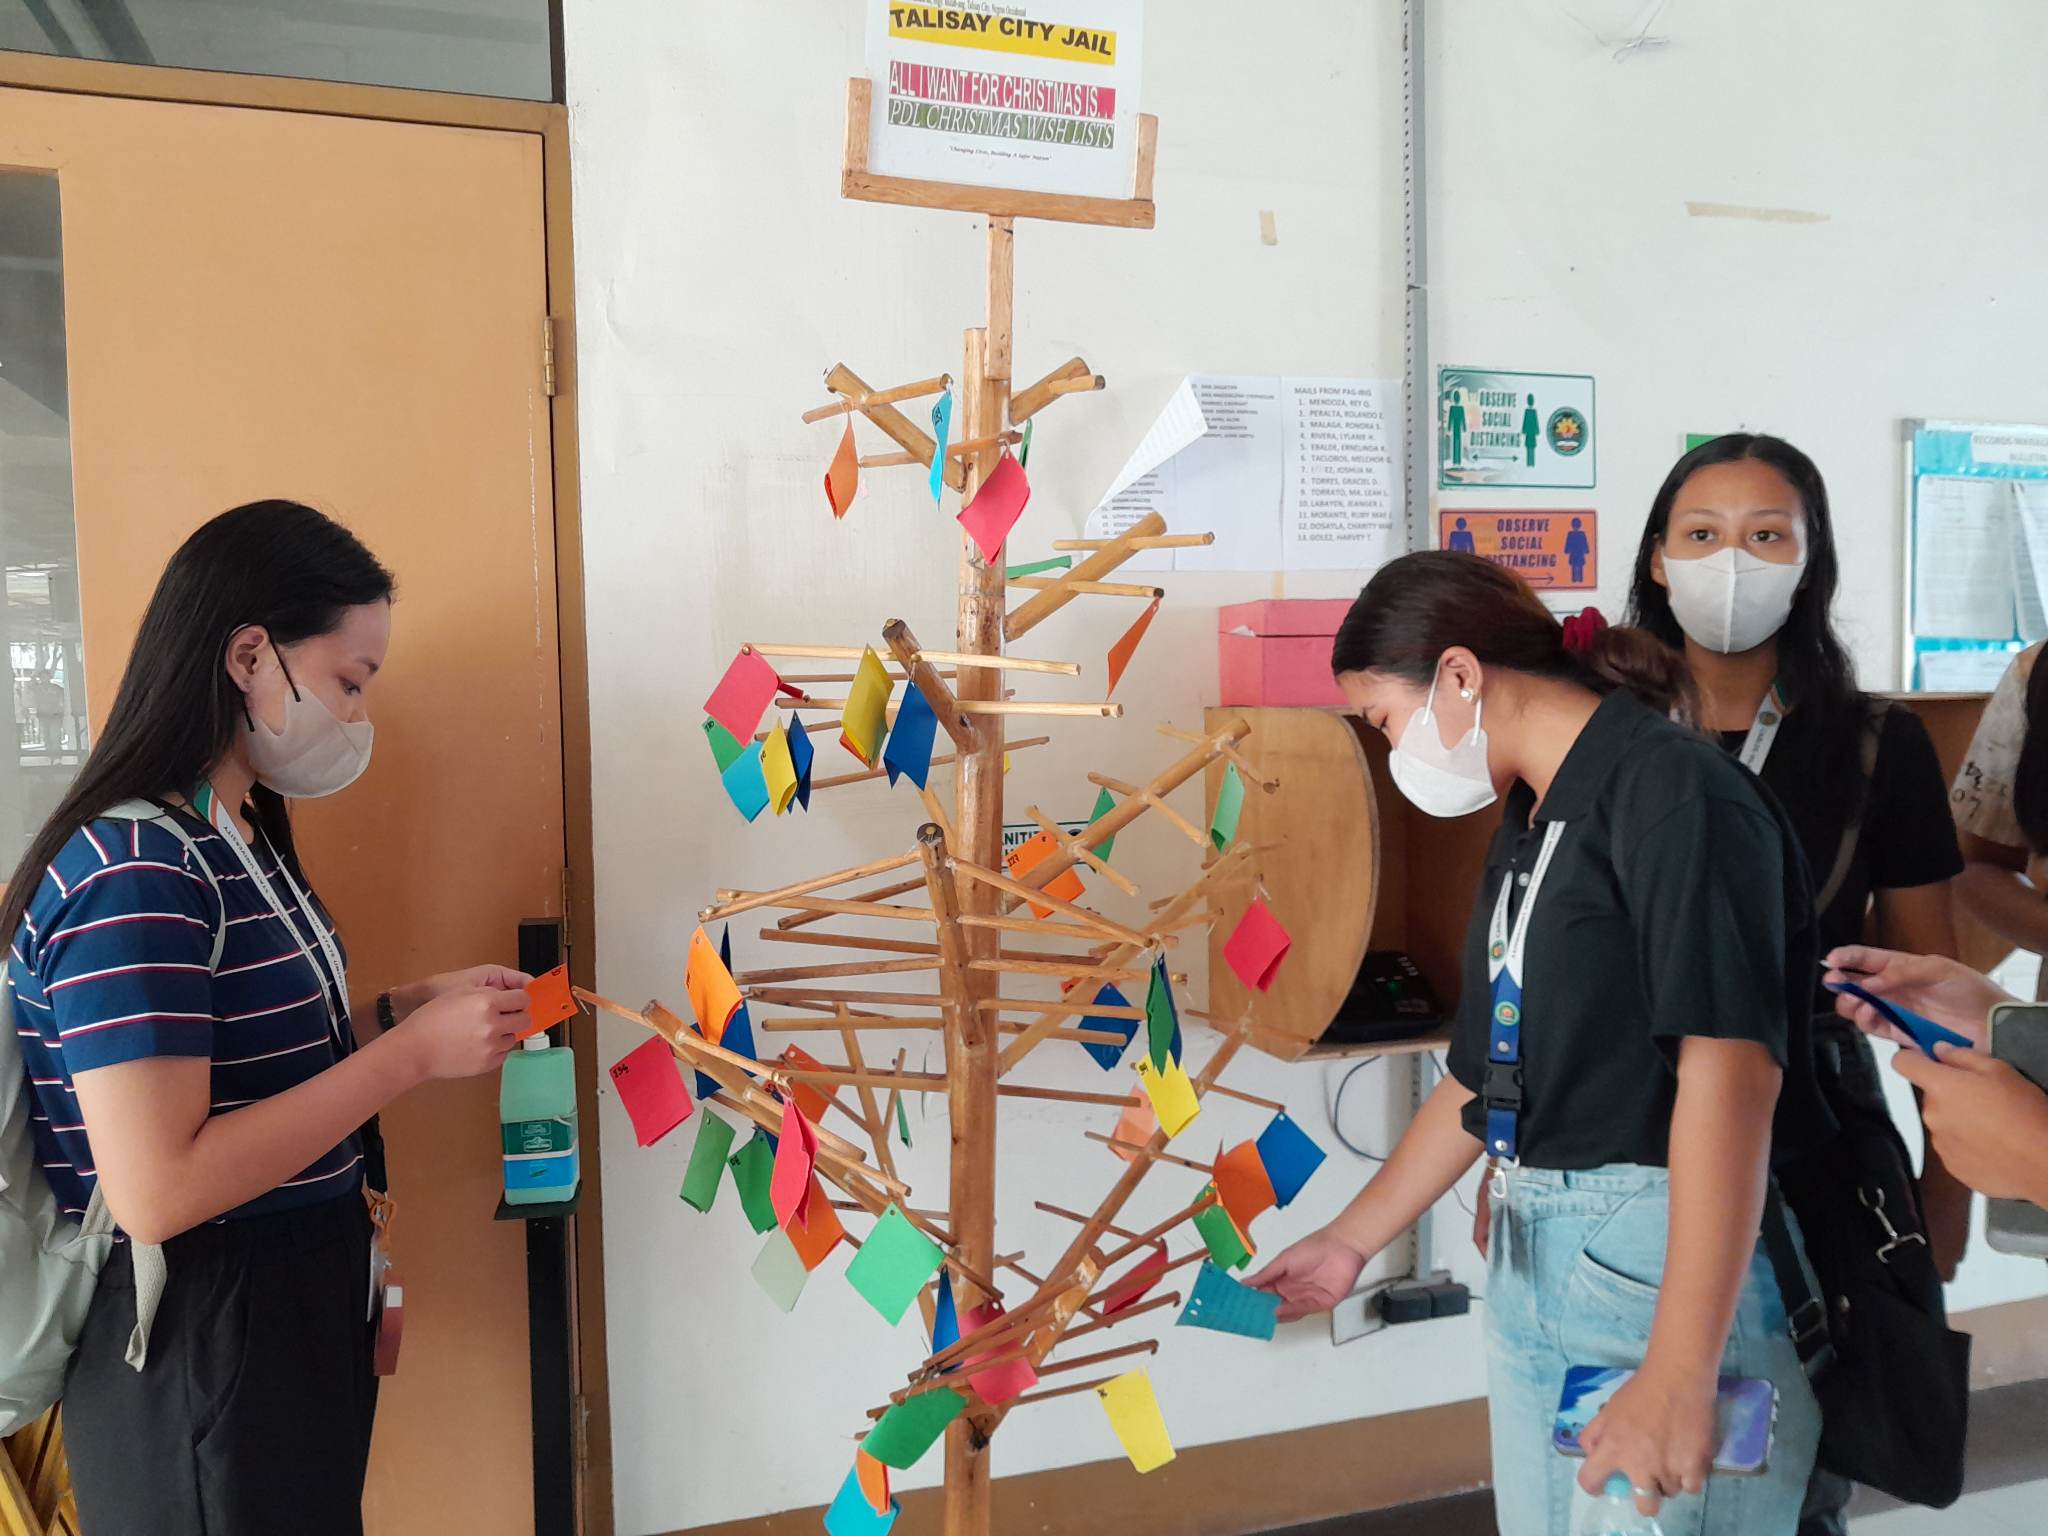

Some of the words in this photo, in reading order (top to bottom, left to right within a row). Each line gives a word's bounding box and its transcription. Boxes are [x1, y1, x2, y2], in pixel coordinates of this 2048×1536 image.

[890, 9, 992, 33] TALISAY
[999, 17, 1055, 41] CITY
[1062, 29, 1112, 55] JAIL
[890, 61, 916, 97] ALL
[919, 65, 924, 98] I
[926, 67, 968, 102] WANT
[971, 72, 999, 107] FOR
[1003, 76, 1081, 116] CHRISTMAS
[889, 100, 921, 126] PDL
[926, 105, 1021, 138] CHRISTMAS
[1026, 115, 1069, 143] WISH
[1071, 120, 1115, 149] LISTS
[1342, 388, 1372, 396] PAG-IBIG
[1479, 391, 1517, 408] OBSERVE
[1309, 399, 1347, 407] MENDOZA,
[1310, 410, 1342, 418] PERALTA,
[1344, 411, 1377, 419] ROLANDO
[1482, 411, 1512, 427] SOCIAL
[1470, 431, 1521, 448] DISTANCING
[1312, 489, 1347, 497] TORRATO,
[1311, 512, 1349, 520] MORANTE,
[1310, 523, 1345, 531] DOSAYLA,
[1497, 518, 1550, 532] OBSERVE
[1310, 534, 1334, 542] GOLEZ,
[1501, 536, 1543, 550] SOCIAL
[222, 824, 255, 869] UNIVERSITY
[252, 869, 269, 893] STATE
[321, 934, 335, 957] STATE
